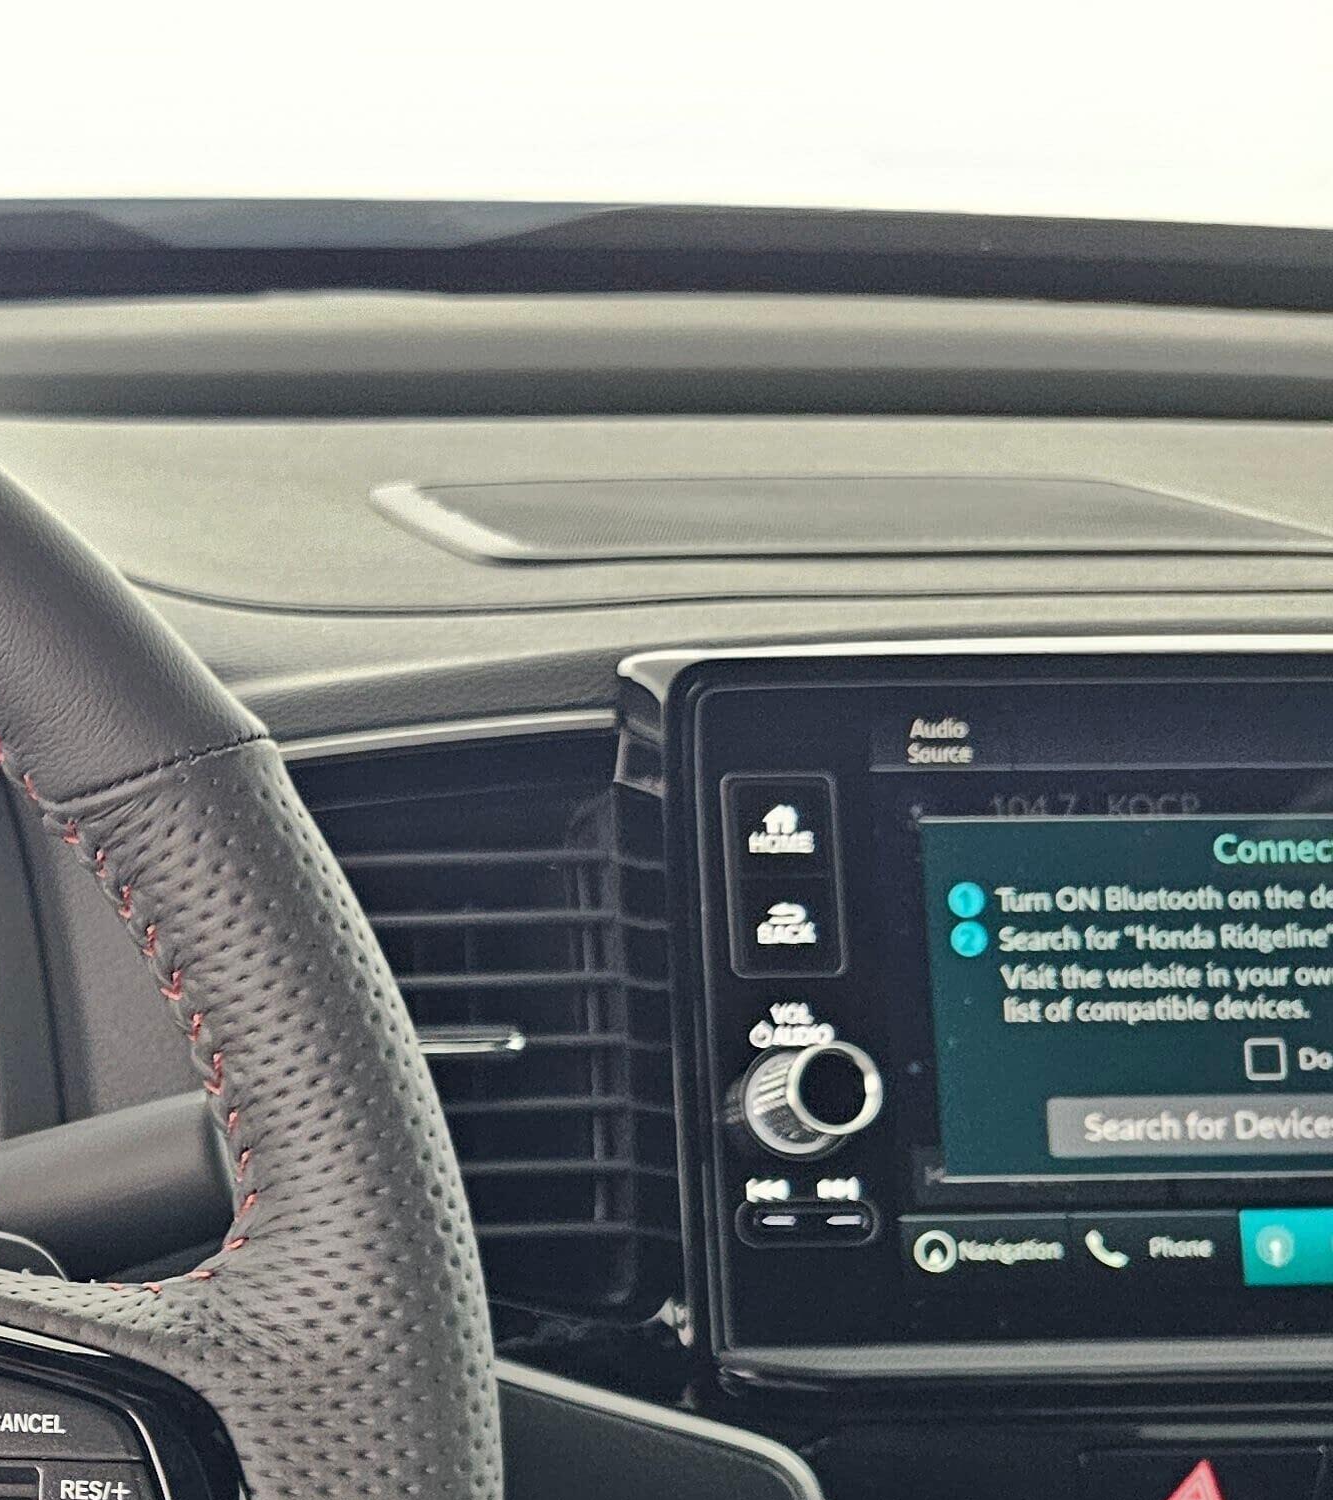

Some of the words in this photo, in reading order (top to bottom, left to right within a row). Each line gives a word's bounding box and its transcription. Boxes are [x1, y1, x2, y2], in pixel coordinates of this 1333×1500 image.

[910, 718, 970, 739] Audio
[907, 743, 973, 764] Source
[749, 831, 815, 853] HOME
[1212, 834, 1333, 864] Connec
[994, 886, 1052, 912] Turn
[1055, 886, 1100, 912] ON
[1105, 885, 1224, 911] Bluetooth
[1228, 889, 1260, 910] on
[1264, 884, 1305, 910] the
[999, 925, 1080, 952] Search
[1085, 925, 1121, 951] for
[999, 964, 1058, 990] Visit
[1062, 964, 1102, 989] the
[1106, 963, 1200, 989] website
[1205, 962, 1229, 987] in
[1234, 965, 1290, 993] your
[1294, 965, 1333, 987] ow
[1004, 998, 1042, 1023] list
[1045, 996, 1074, 1022] of
[1076, 995, 1209, 1026] compatible
[1214, 994, 1311, 1021] devices.
[1084, 1110, 1179, 1142] Search
[1186, 1110, 1229, 1141] for
[1235, 1108, 1333, 1140] Device
[958, 1238, 1066, 1266] Navigation
[1149, 1236, 1215, 1260] Phone
